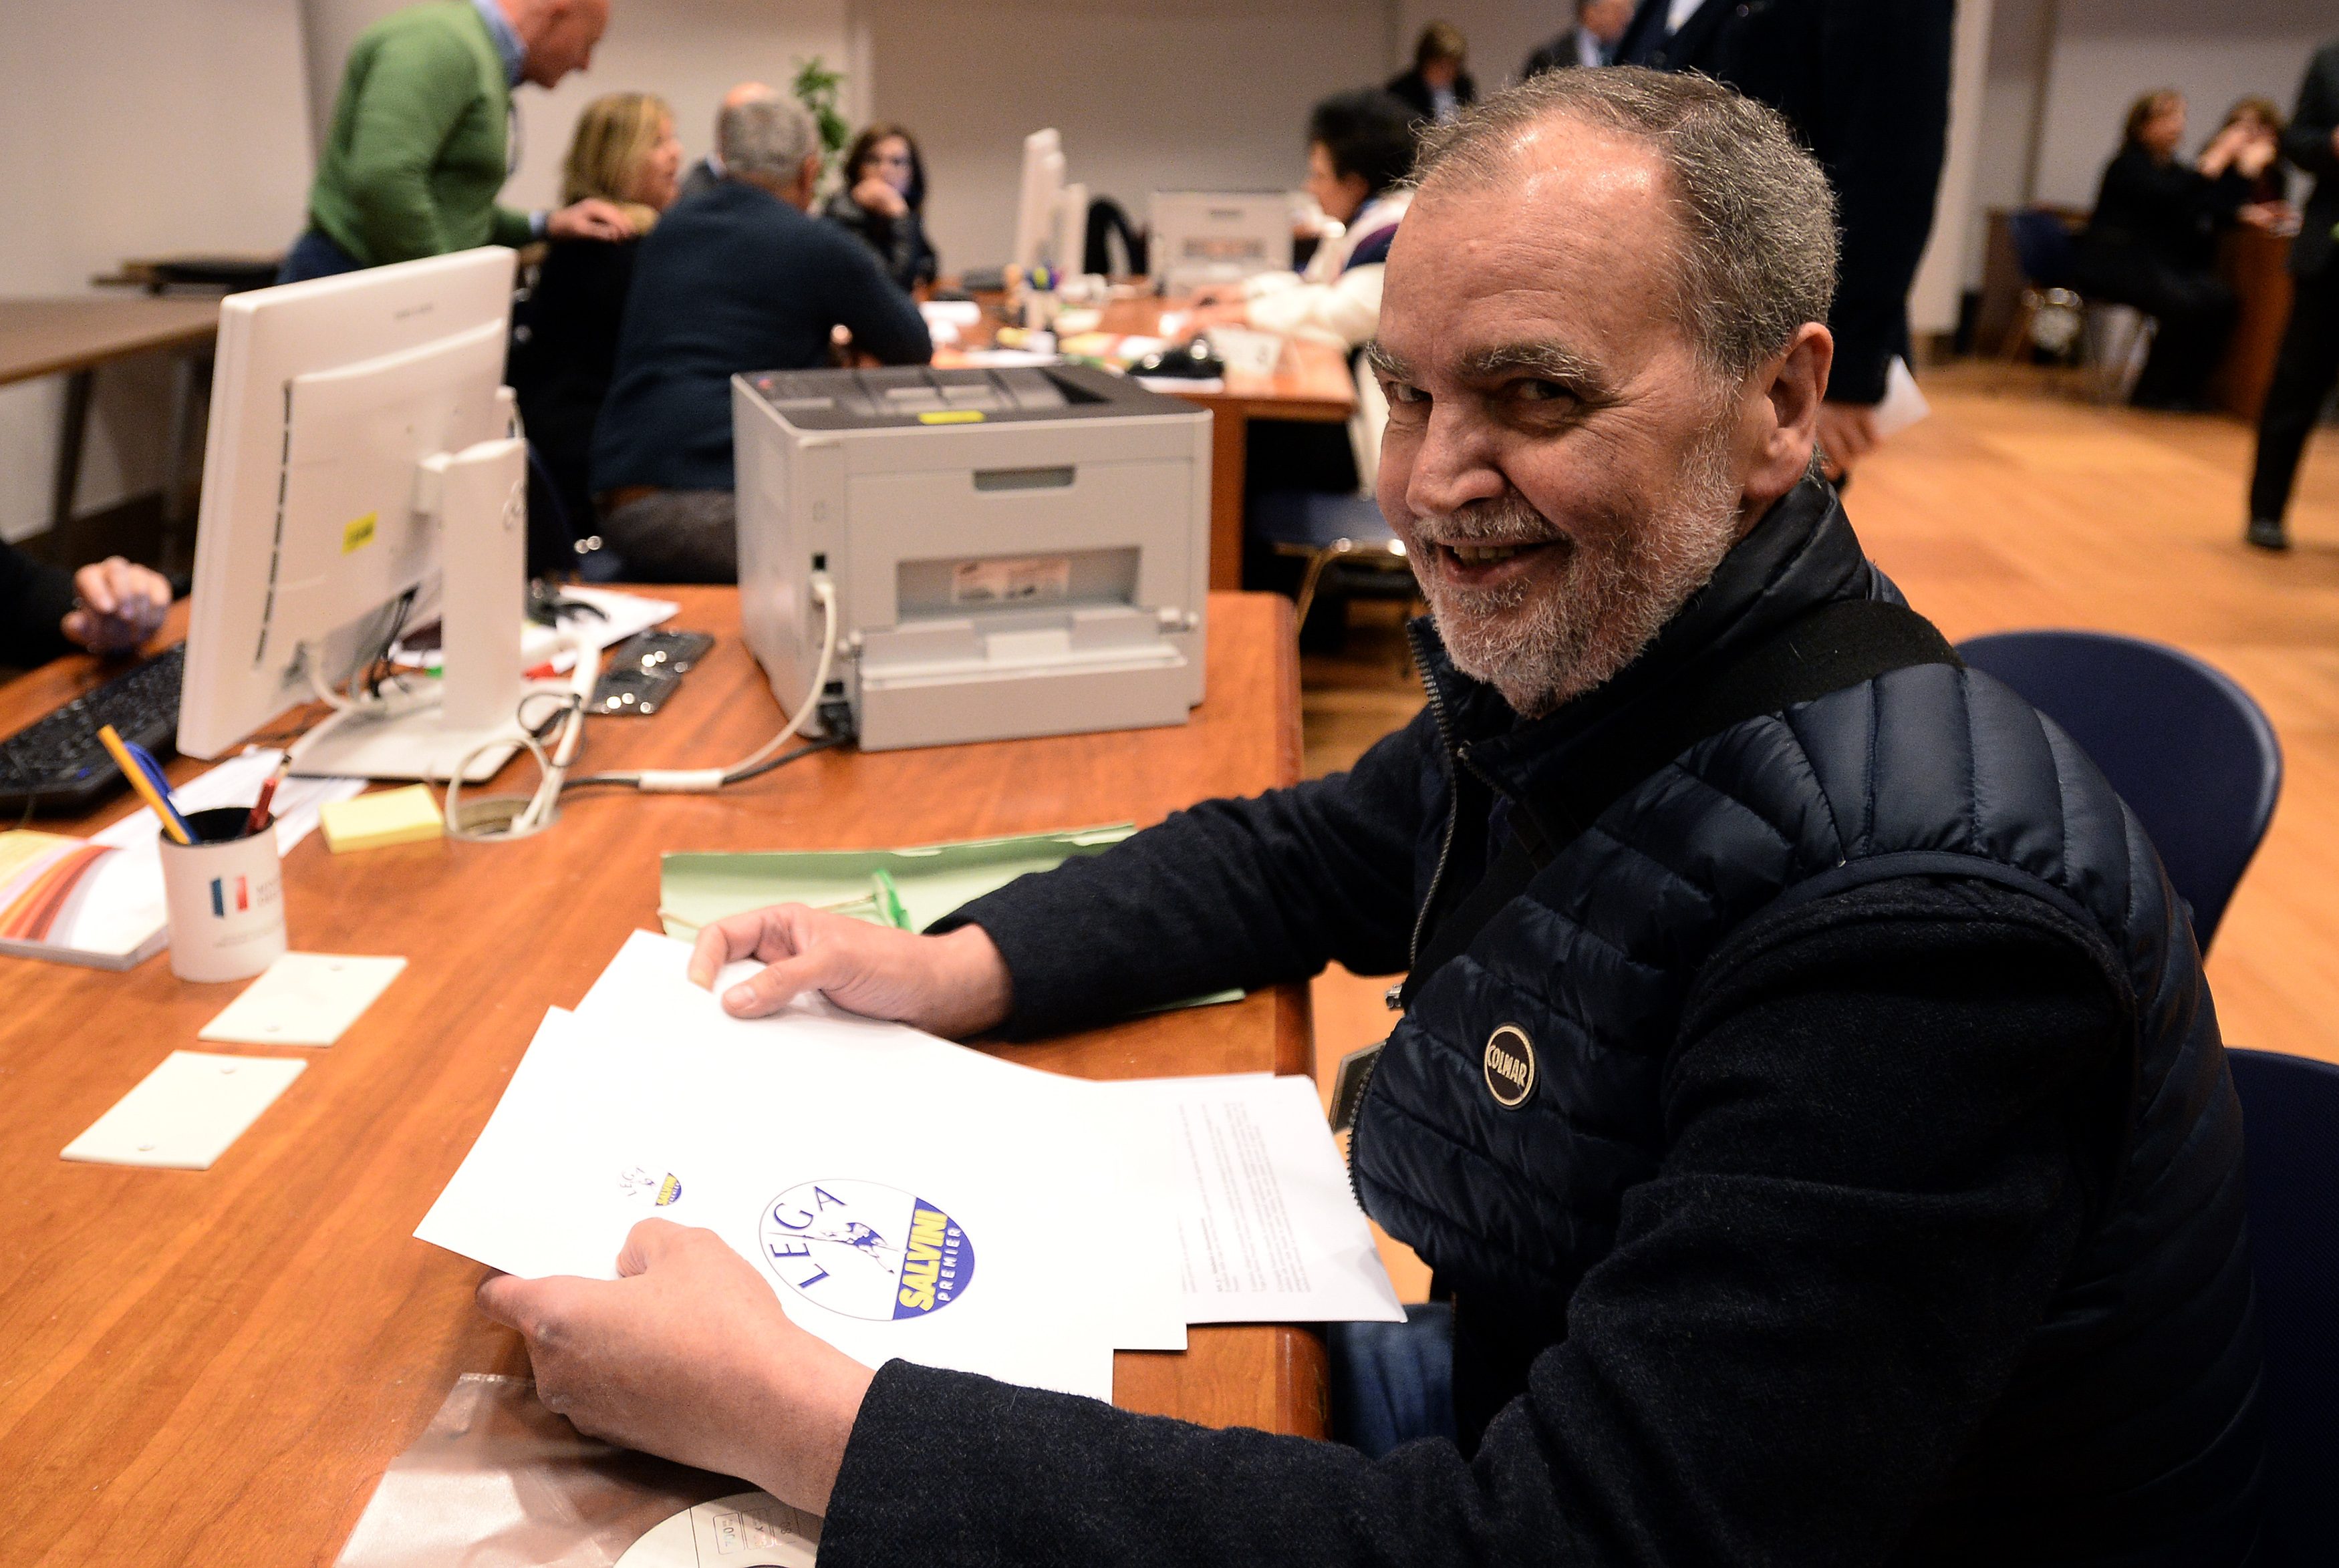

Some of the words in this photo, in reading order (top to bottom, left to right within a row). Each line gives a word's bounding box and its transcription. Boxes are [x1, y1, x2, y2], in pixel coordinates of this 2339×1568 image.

[1488, 1044, 1527, 1088] COLMAR
[769, 1186, 847, 1289] LEGA
[898, 1209, 948, 1311] SALVINI
[936, 1227, 962, 1302] PREMIER
